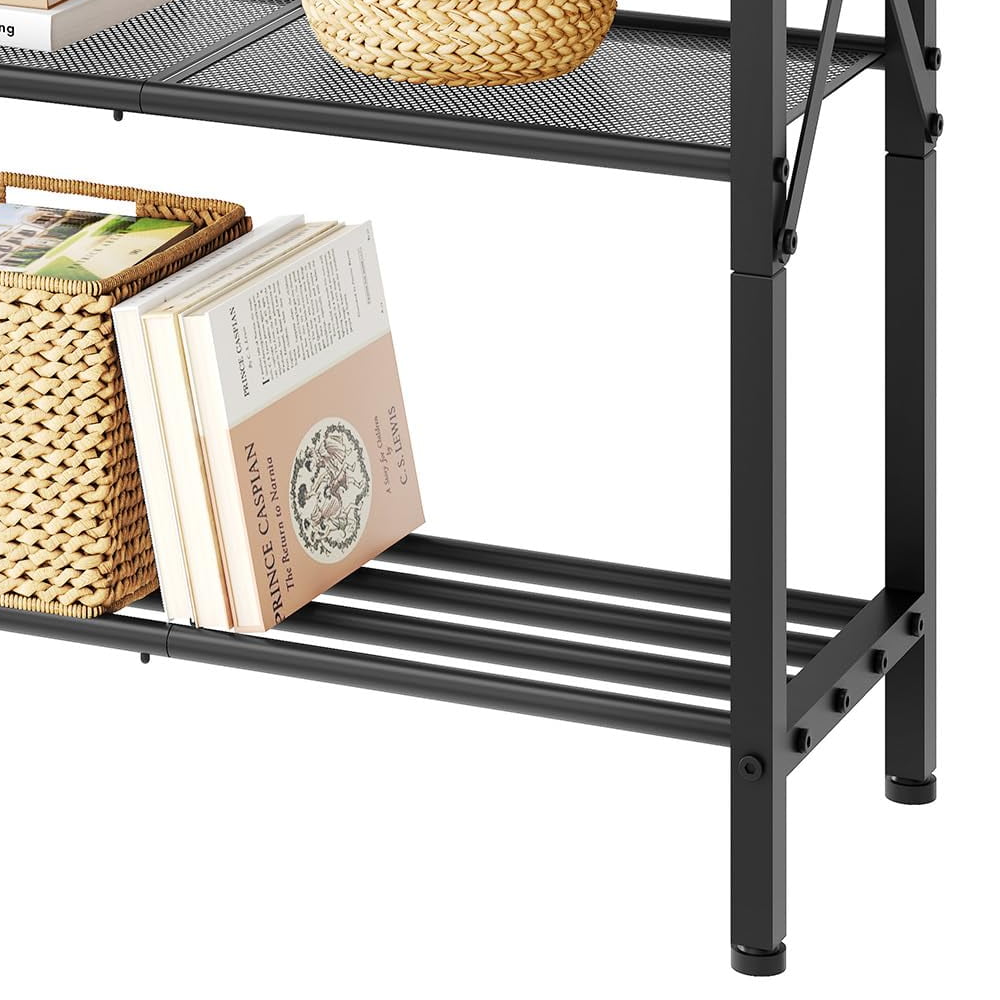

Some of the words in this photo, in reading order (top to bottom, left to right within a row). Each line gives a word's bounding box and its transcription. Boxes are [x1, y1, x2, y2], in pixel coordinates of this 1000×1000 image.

[228, 306, 242, 354] CASPIAN
[238, 356, 250, 397] PRINCE
[387, 405, 403, 453] LEWIS
[245, 441, 270, 535] CASPIAN
[267, 456, 280, 501] Narnia
[275, 505, 283, 518] to
[276, 520, 290, 563] Return
[262, 540, 286, 626] PRINCE
[285, 567, 295, 592] The
